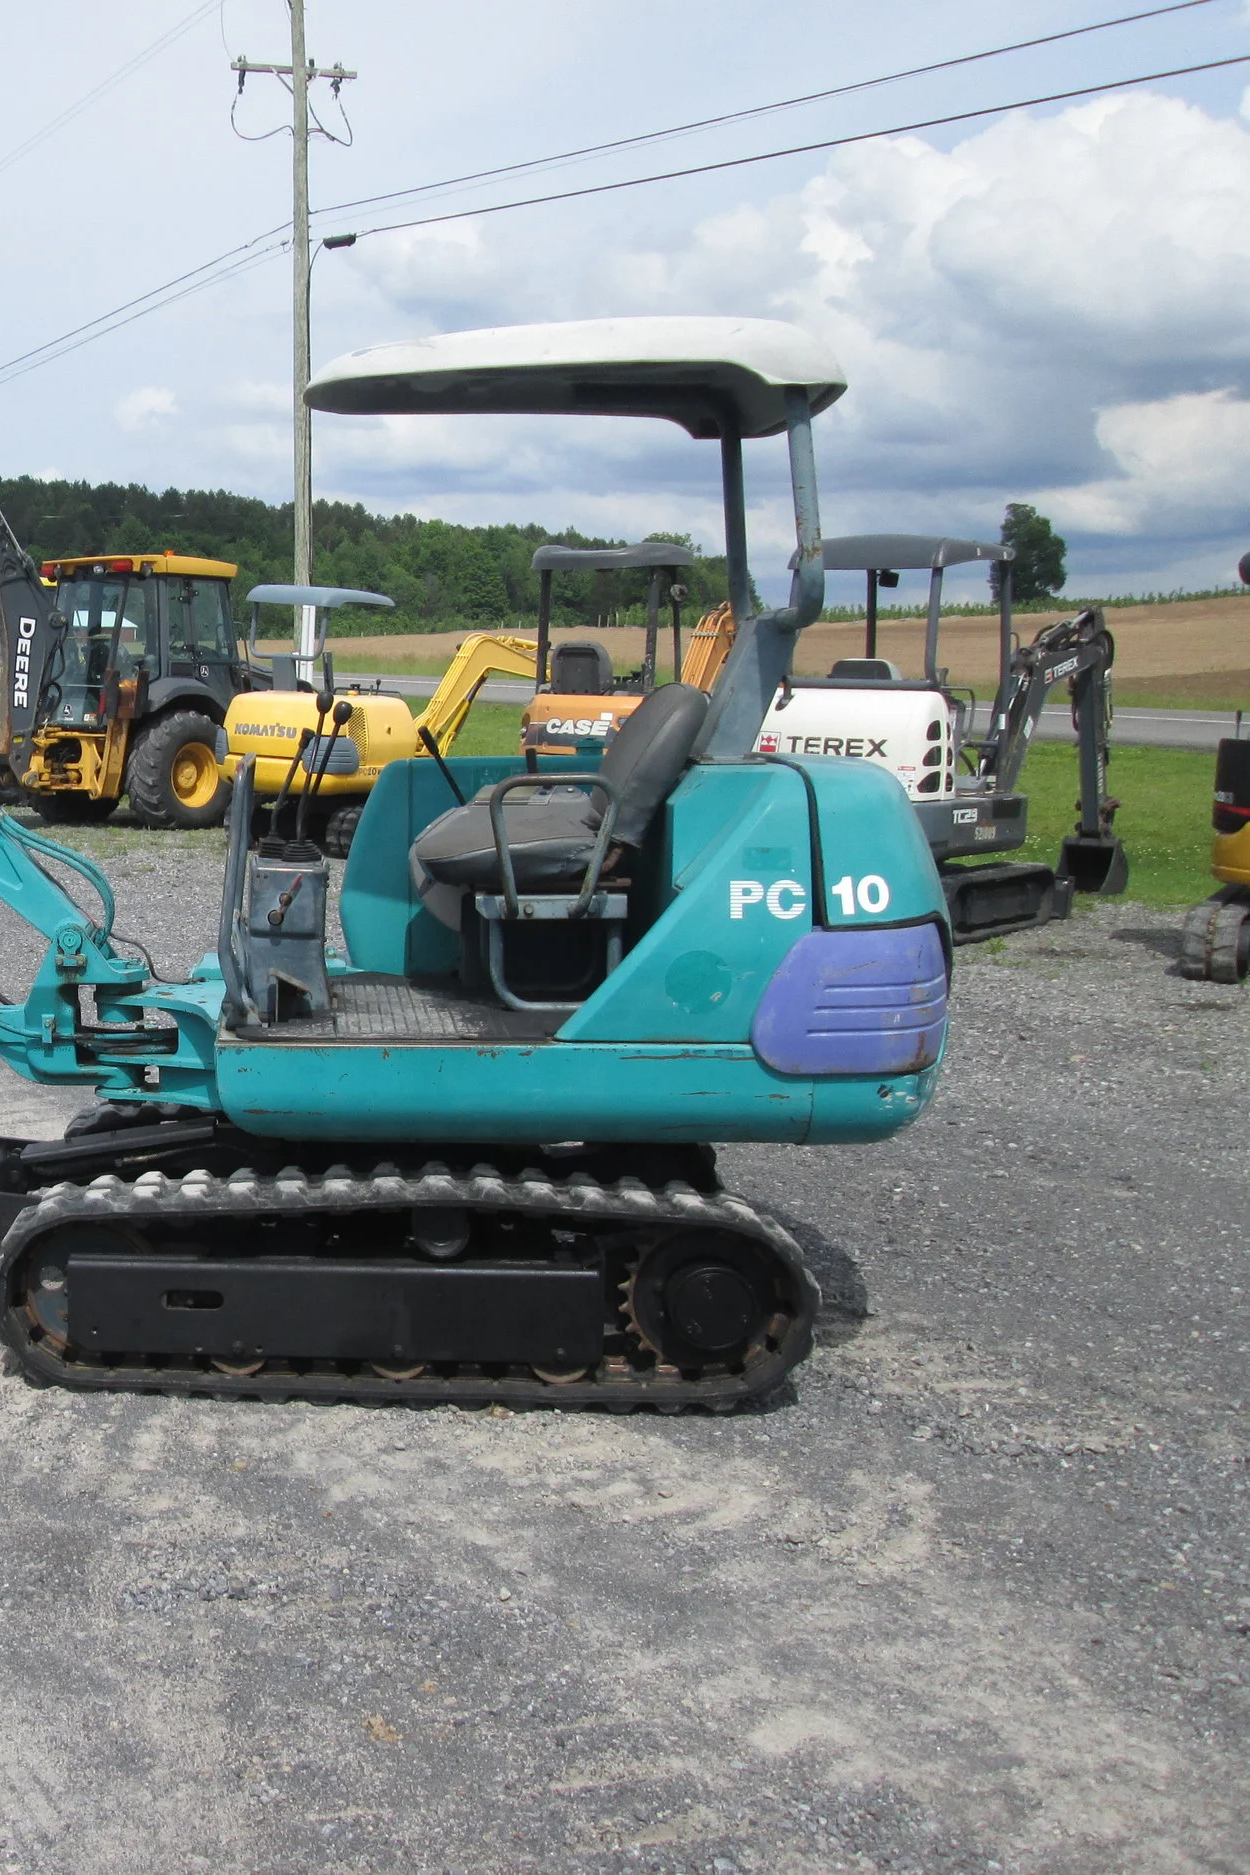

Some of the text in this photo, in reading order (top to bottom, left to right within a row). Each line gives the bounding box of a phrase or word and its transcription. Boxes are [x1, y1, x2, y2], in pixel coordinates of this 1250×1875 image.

[13, 616, 37, 709] DEERE
[1053, 655, 1079, 678] TEREX
[234, 722, 297, 739] KOMATSU
[546, 718, 611, 737] CASE
[786, 735, 888, 758] TEREX
[953, 808, 977, 824] TC29
[729, 874, 891, 920] PC 10
